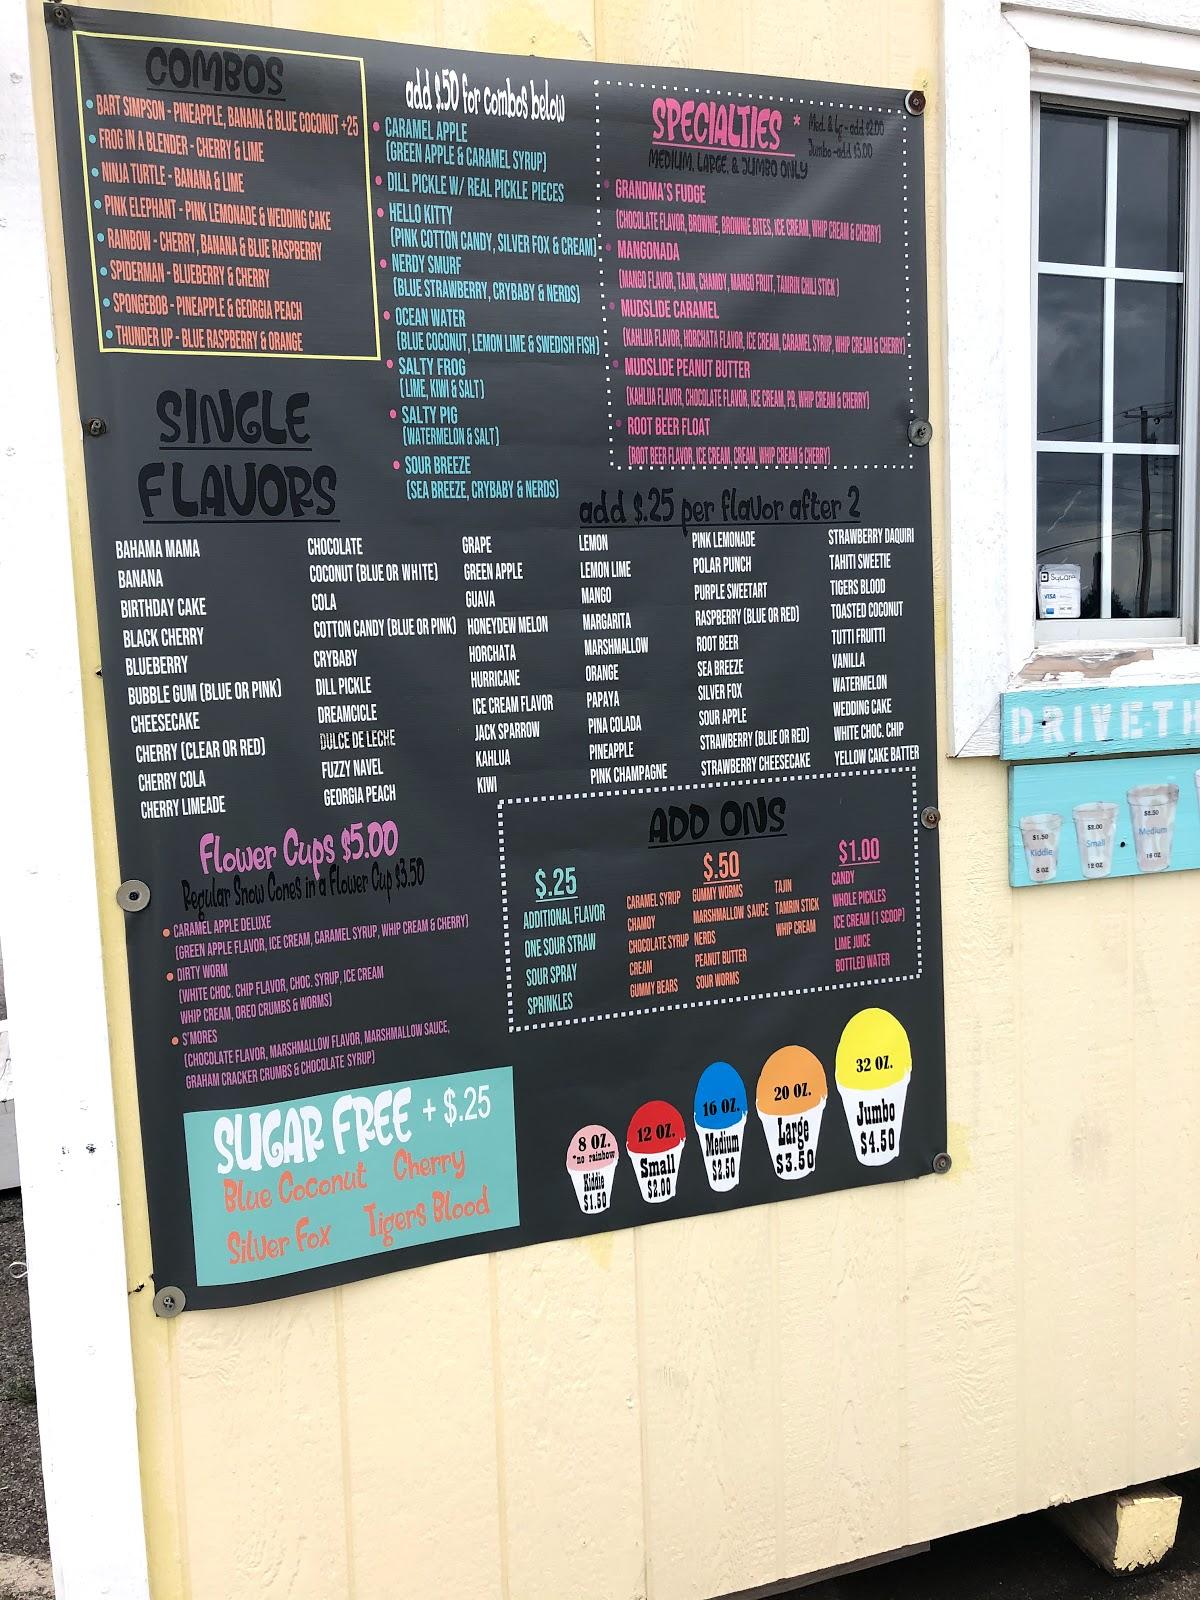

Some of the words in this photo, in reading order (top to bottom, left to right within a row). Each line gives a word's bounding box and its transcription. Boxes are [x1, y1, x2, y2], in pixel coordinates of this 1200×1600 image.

[145, 46, 284, 96] COMBOS
[405, 66, 432, 110] add
[434, 69, 459, 113] $.50
[461, 72, 481, 115] for
[482, 77, 528, 119] combos
[529, 78, 565, 123] below
[384, 116, 434, 140] CARAMEL
[436, 120, 468, 143] APPLE
[652, 97, 783, 150] SPECIALTIES
[424, 143, 455, 165] APPLE
[465, 146, 511, 169] CARAMEL
[512, 150, 546, 173] SYRUP)
[386, 171, 410, 192] DILL
[411, 173, 447, 195] PICKLE
[448, 175, 465, 195] W/
[467, 176, 492, 198] REAL
[493, 178, 528, 200] PICKLE
[530, 181, 564, 202] PIECES
[615, 178, 673, 202] GRANDMA'S
[675, 183, 706, 204] FUDGE
[388, 202, 421, 223] HELLO
[423, 204, 453, 225] KITTY
[617, 239, 680, 261] MANGONADA
[391, 253, 425, 273] NERDY
[427, 254, 461, 275] SMURF
[112, 292, 168, 315] SPONGEBOB
[175, 295, 225, 317] PINEAPPLE
[235, 298, 273, 319] GEORGIA
[273, 300, 303, 321] PEACH
[395, 306, 429, 326] OCEAN
[430, 308, 466, 327] WATER
[398, 356, 434, 375] SALTY
[436, 357, 466, 376] FROG
[624, 357, 674, 376] MUDSLIDE
[676, 357, 713, 377] PEANUT
[715, 359, 750, 378] BUTTER
[155, 388, 311, 445] SINGLE
[401, 405, 437, 424] SALTY
[439, 405, 458, 424] PIG
[627, 416, 653, 435] ROOT
[654, 416, 679, 435] BEER
[681, 417, 710, 436] FLOAT
[404, 455, 432, 474] SOUR
[433, 455, 471, 474] BREEZE
[136, 461, 337, 518] FLAVORS
[579, 489, 627, 525] add
[634, 487, 674, 523] $.25
[682, 499, 715, 537] per
[789, 489, 843, 522] after
[848, 485, 860, 518] 2
[307, 537, 363, 555] CHOCOLATE
[461, 535, 492, 554] GRAPE
[578, 533, 608, 551] LEMON
[117, 568, 164, 588] BANANA
[311, 592, 337, 611] COLA
[465, 589, 496, 608] GUAVA
[580, 586, 612, 604] MANGO
[120, 597, 174, 618] BIRTHDAY
[177, 597, 207, 616] CAKE
[582, 612, 632, 630] MARGARITA
[468, 643, 516, 662] HORCHATA
[583, 636, 649, 656] MARSHMALLOW
[125, 655, 188, 676] BLUEBERRY
[313, 648, 358, 668] CRYBABY
[831, 651, 866, 669] VANILLA
[470, 669, 521, 688] HURRICANE
[584, 663, 619, 682] ORANGE
[832, 673, 887, 692] WATERMELON
[130, 711, 200, 733] CHEESECAKE
[317, 703, 377, 724] DREAMCICLE
[475, 748, 511, 767] KAHLUA
[589, 741, 634, 760] PINEAPPLE
[476, 775, 497, 794] KIWI
[648, 807, 710, 844] ADD
[719, 796, 787, 837] ONS
[199, 832, 277, 875] Flower
[283, 827, 336, 880] Cups
[341, 820, 399, 864] $5.00
[838, 837, 880, 863] $1.00
[703, 850, 740, 881] $.50
[534, 866, 578, 899] $.25
[773, 878, 792, 894] TAJIN
[831, 869, 855, 886] CANDY
[173, 918, 212, 938] CARAMEL
[213, 918, 239, 933] APPLE
[240, 914, 272, 931] DELUXE
[523, 907, 573, 929] ADDITIONAL
[573, 903, 605, 924] FLAVOR
[627, 914, 656, 932] CHAMOY
[693, 929, 716, 946] NERDS
[176, 965, 200, 982] DIRTY
[201, 962, 228, 978] WORM
[525, 966, 549, 987] SOUR
[549, 963, 577, 984] SPRAY
[629, 959, 653, 976] CREAM
[527, 991, 573, 1015] SPRINKLES
[181, 1028, 218, 1046] S'MORES
[855, 1057, 871, 1073] 32
[874, 1054, 893, 1070] OZ.
[773, 1085, 790, 1101] 20
[793, 1082, 811, 1098] OZ.
[702, 1100, 717, 1117] 16
[721, 1098, 740, 1115] OZ.
[856, 1099, 896, 1126] Jumbo
[213, 1106, 325, 1174] SUGAR
[331, 1087, 413, 1155] FREE
[443, 1084, 491, 1128] $.25
[637, 1126, 652, 1143] 12
[655, 1122, 675, 1140] OZ.
[778, 1117, 809, 1150] Large
[578, 1136, 587, 1152] 8
[590, 1133, 611, 1150] OZ.
[705, 1132, 739, 1156] Medium
[860, 1127, 895, 1156] $4.50
[391, 1147, 466, 1182] Cherry
[588, 1151, 615, 1162] rainbow
[640, 1154, 676, 1178] Small
[776, 1149, 814, 1174] $3.50
[711, 1156, 735, 1182] $2.50
[223, 1178, 273, 1213] Blue
[278, 1161, 368, 1207] Coconut
[583, 1172, 605, 1192] Kiddie
[647, 1177, 671, 1199] $2.00
[583, 1191, 607, 1212] $1.50
[363, 1204, 427, 1247] Tigers
[431, 1183, 491, 1224] Blood
[294, 1215, 331, 1253] Fox
